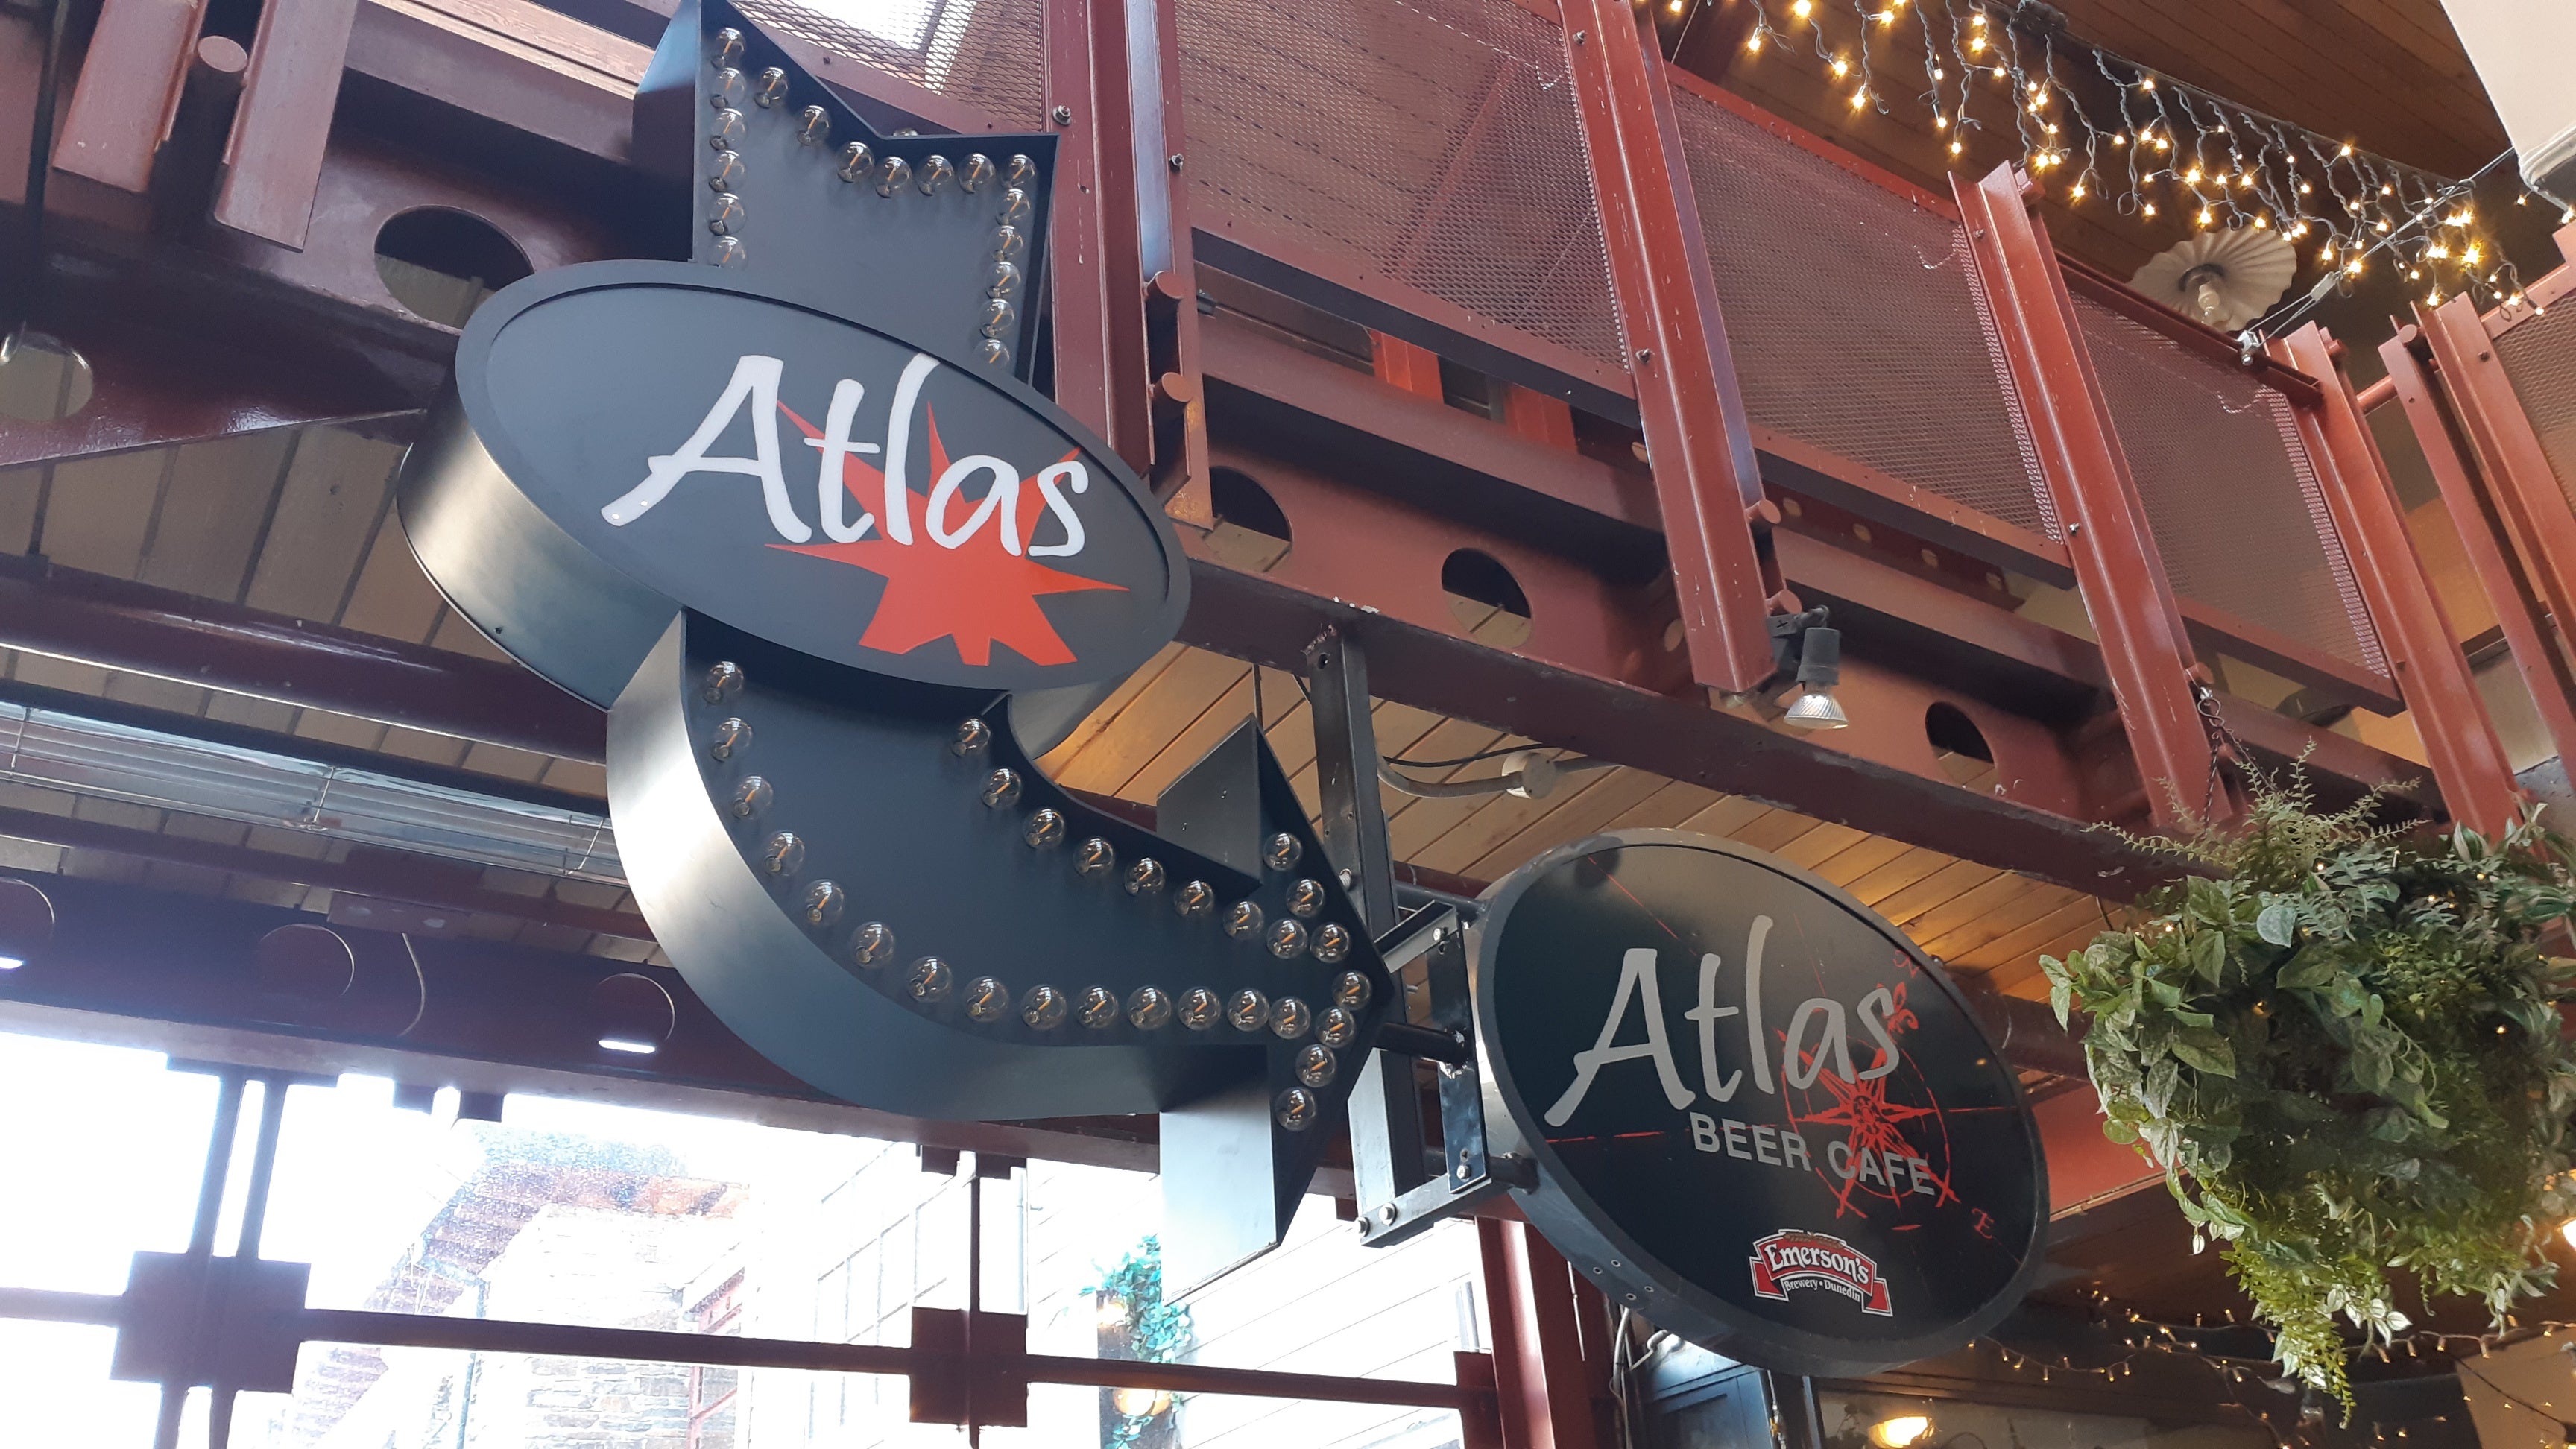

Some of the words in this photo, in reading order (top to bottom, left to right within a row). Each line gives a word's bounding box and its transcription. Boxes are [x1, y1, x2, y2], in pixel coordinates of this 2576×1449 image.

[601, 354, 1089, 558] Atlas
[1544, 915, 1901, 1127] Atlas
[1690, 1111, 1811, 1172] BEER
[1828, 1140, 1936, 1196] CAFE
[1764, 1243, 1869, 1284] Emerson's
[1784, 1279, 1819, 1292] Brewery
[1824, 1279, 1861, 1303] Dunedin
